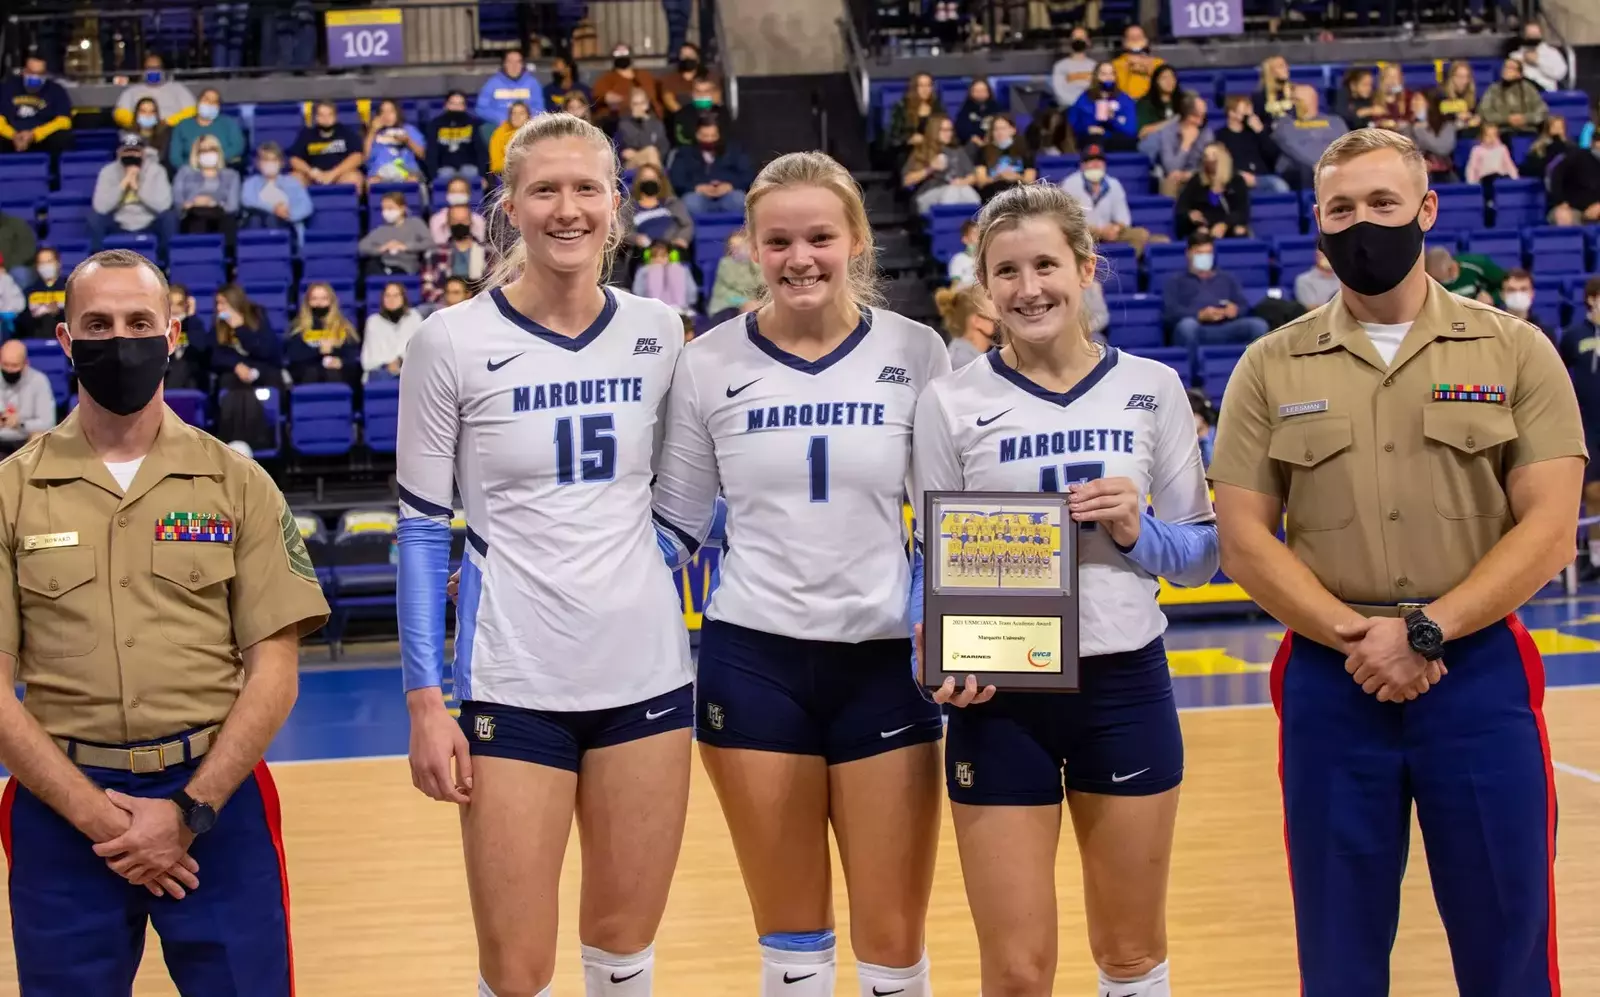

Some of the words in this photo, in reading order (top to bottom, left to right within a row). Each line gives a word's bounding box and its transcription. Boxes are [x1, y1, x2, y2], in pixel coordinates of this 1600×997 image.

[1185, 1, 1230, 28] 103
[341, 29, 389, 58] 102
[634, 345, 663, 353] EAST
[636, 337, 657, 345] BIG
[877, 373, 912, 383] EAST
[881, 366, 906, 375] BIG
[512, 376, 643, 414] MARQUETTE
[1126, 400, 1159, 411] EAST
[1130, 393, 1156, 402] BIG
[745, 401, 886, 432] MARQUETTE
[553, 412, 617, 486] 15
[998, 428, 1135, 464] MARQUETTE
[806, 434, 829, 503] 1
[474, 714, 496, 741] MU
[706, 702, 725, 730] MU
[955, 761, 975, 787] MU
